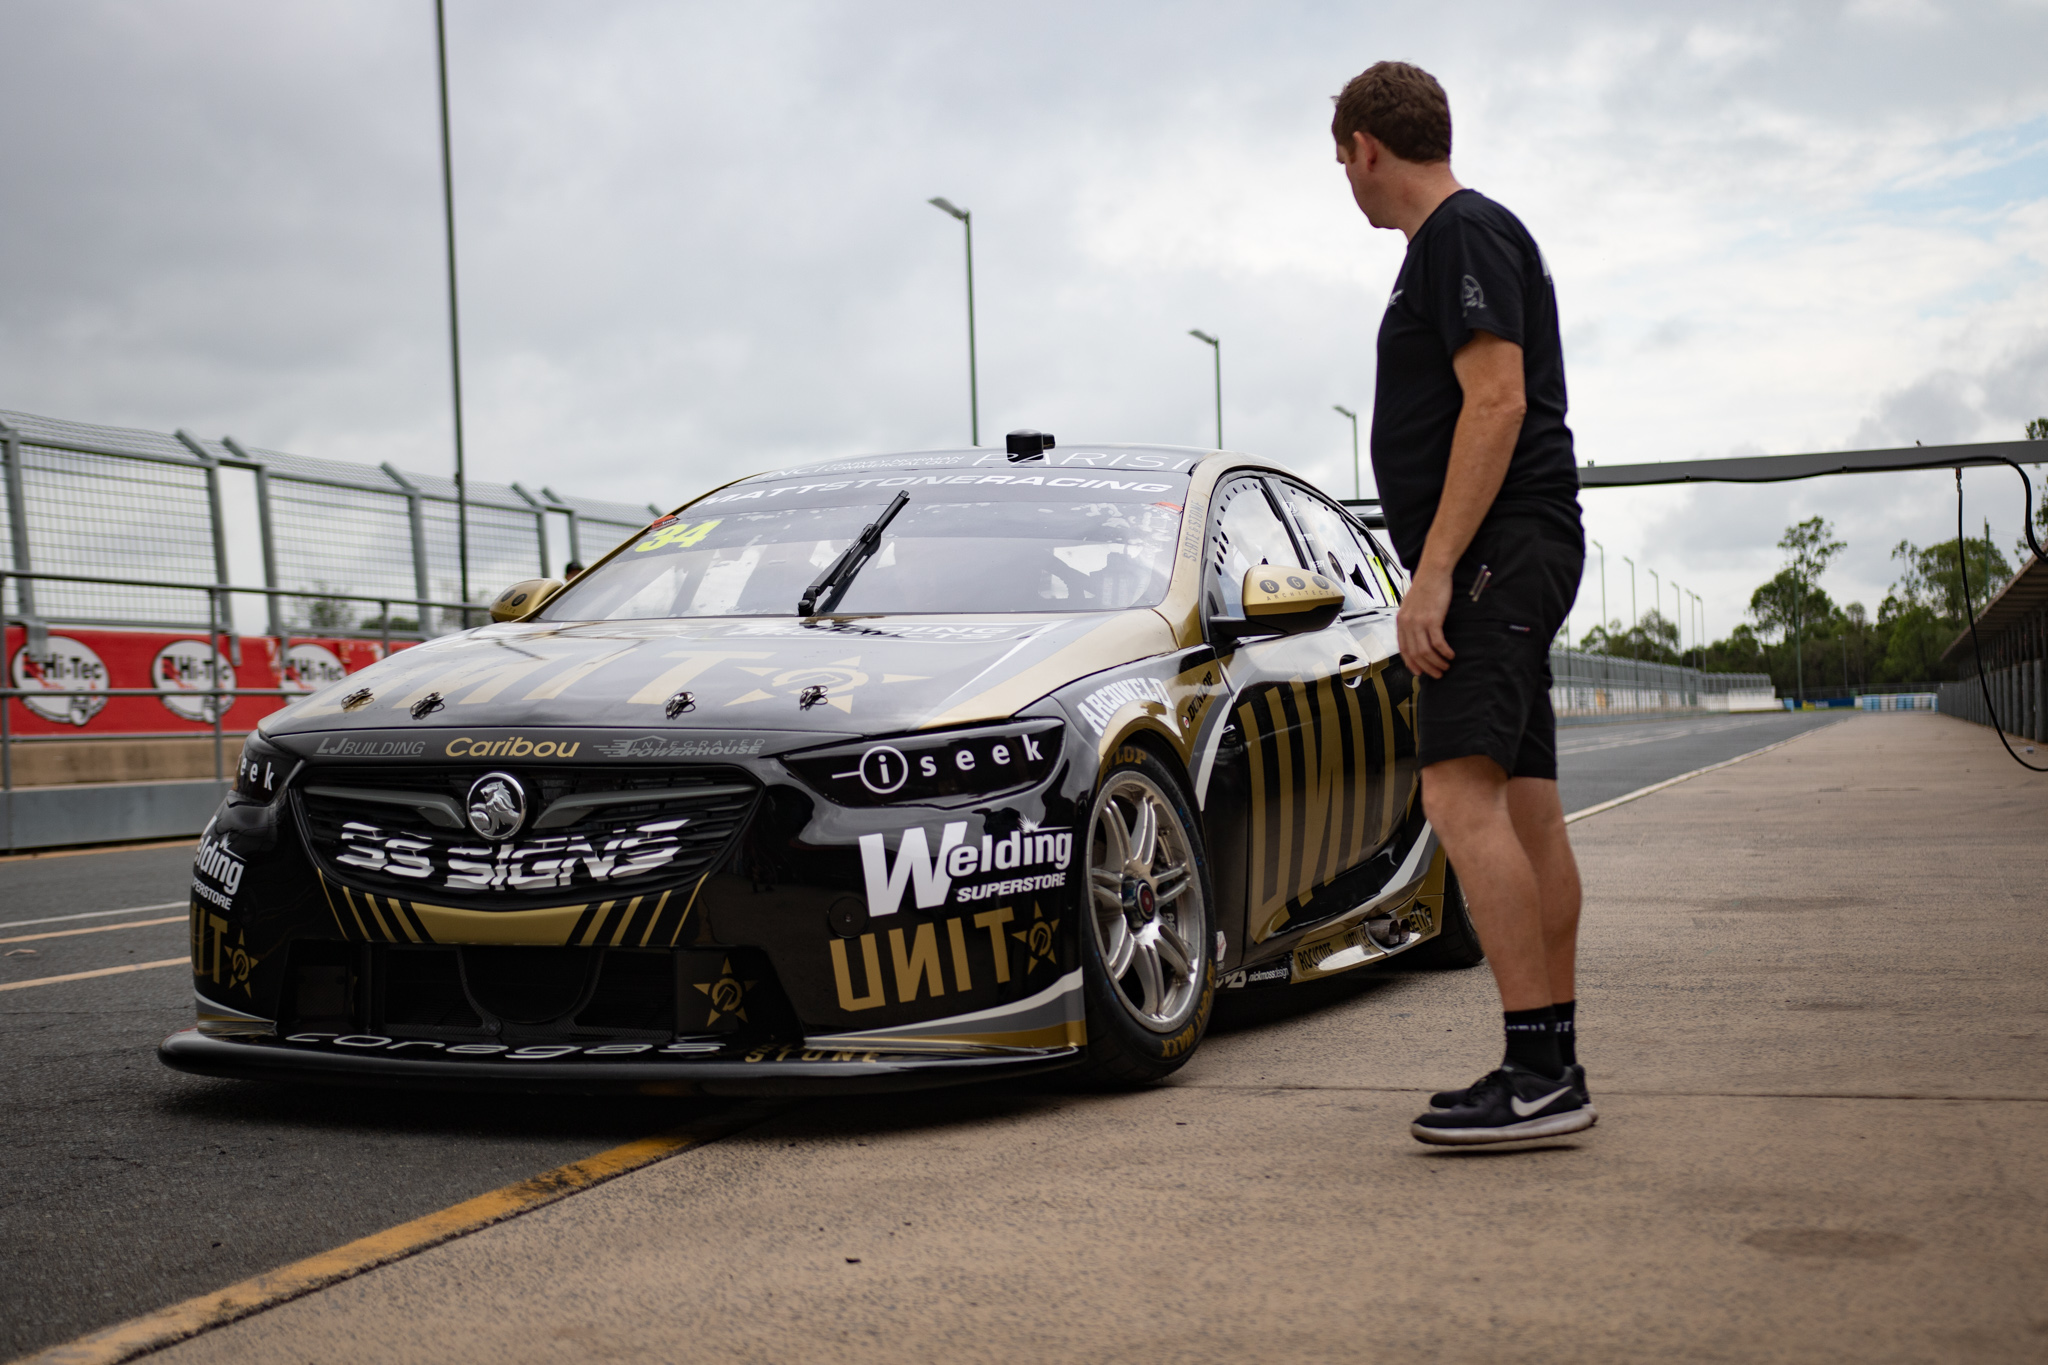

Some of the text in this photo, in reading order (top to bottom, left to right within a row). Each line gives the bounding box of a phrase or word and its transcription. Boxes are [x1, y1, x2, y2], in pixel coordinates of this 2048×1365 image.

[972, 452, 1191, 471] PARISI
[634, 517, 725, 552] 34
[179, 655, 230, 680] Hi-Tc
[1076, 677, 1175, 737] ARCOWELD
[1187, 671, 1213, 722] DUNLOP
[445, 737, 580, 758] Caribou
[627, 745, 763, 758] POWERHOUSE
[632, 738, 766, 750] INTEGRATED
[240, 757, 275, 791] eek
[858, 821, 1073, 918] Welding
[957, 872, 1067, 902] SUPERSTORE
[829, 906, 1016, 1012] UNIT
[285, 1032, 727, 1059] coregas
